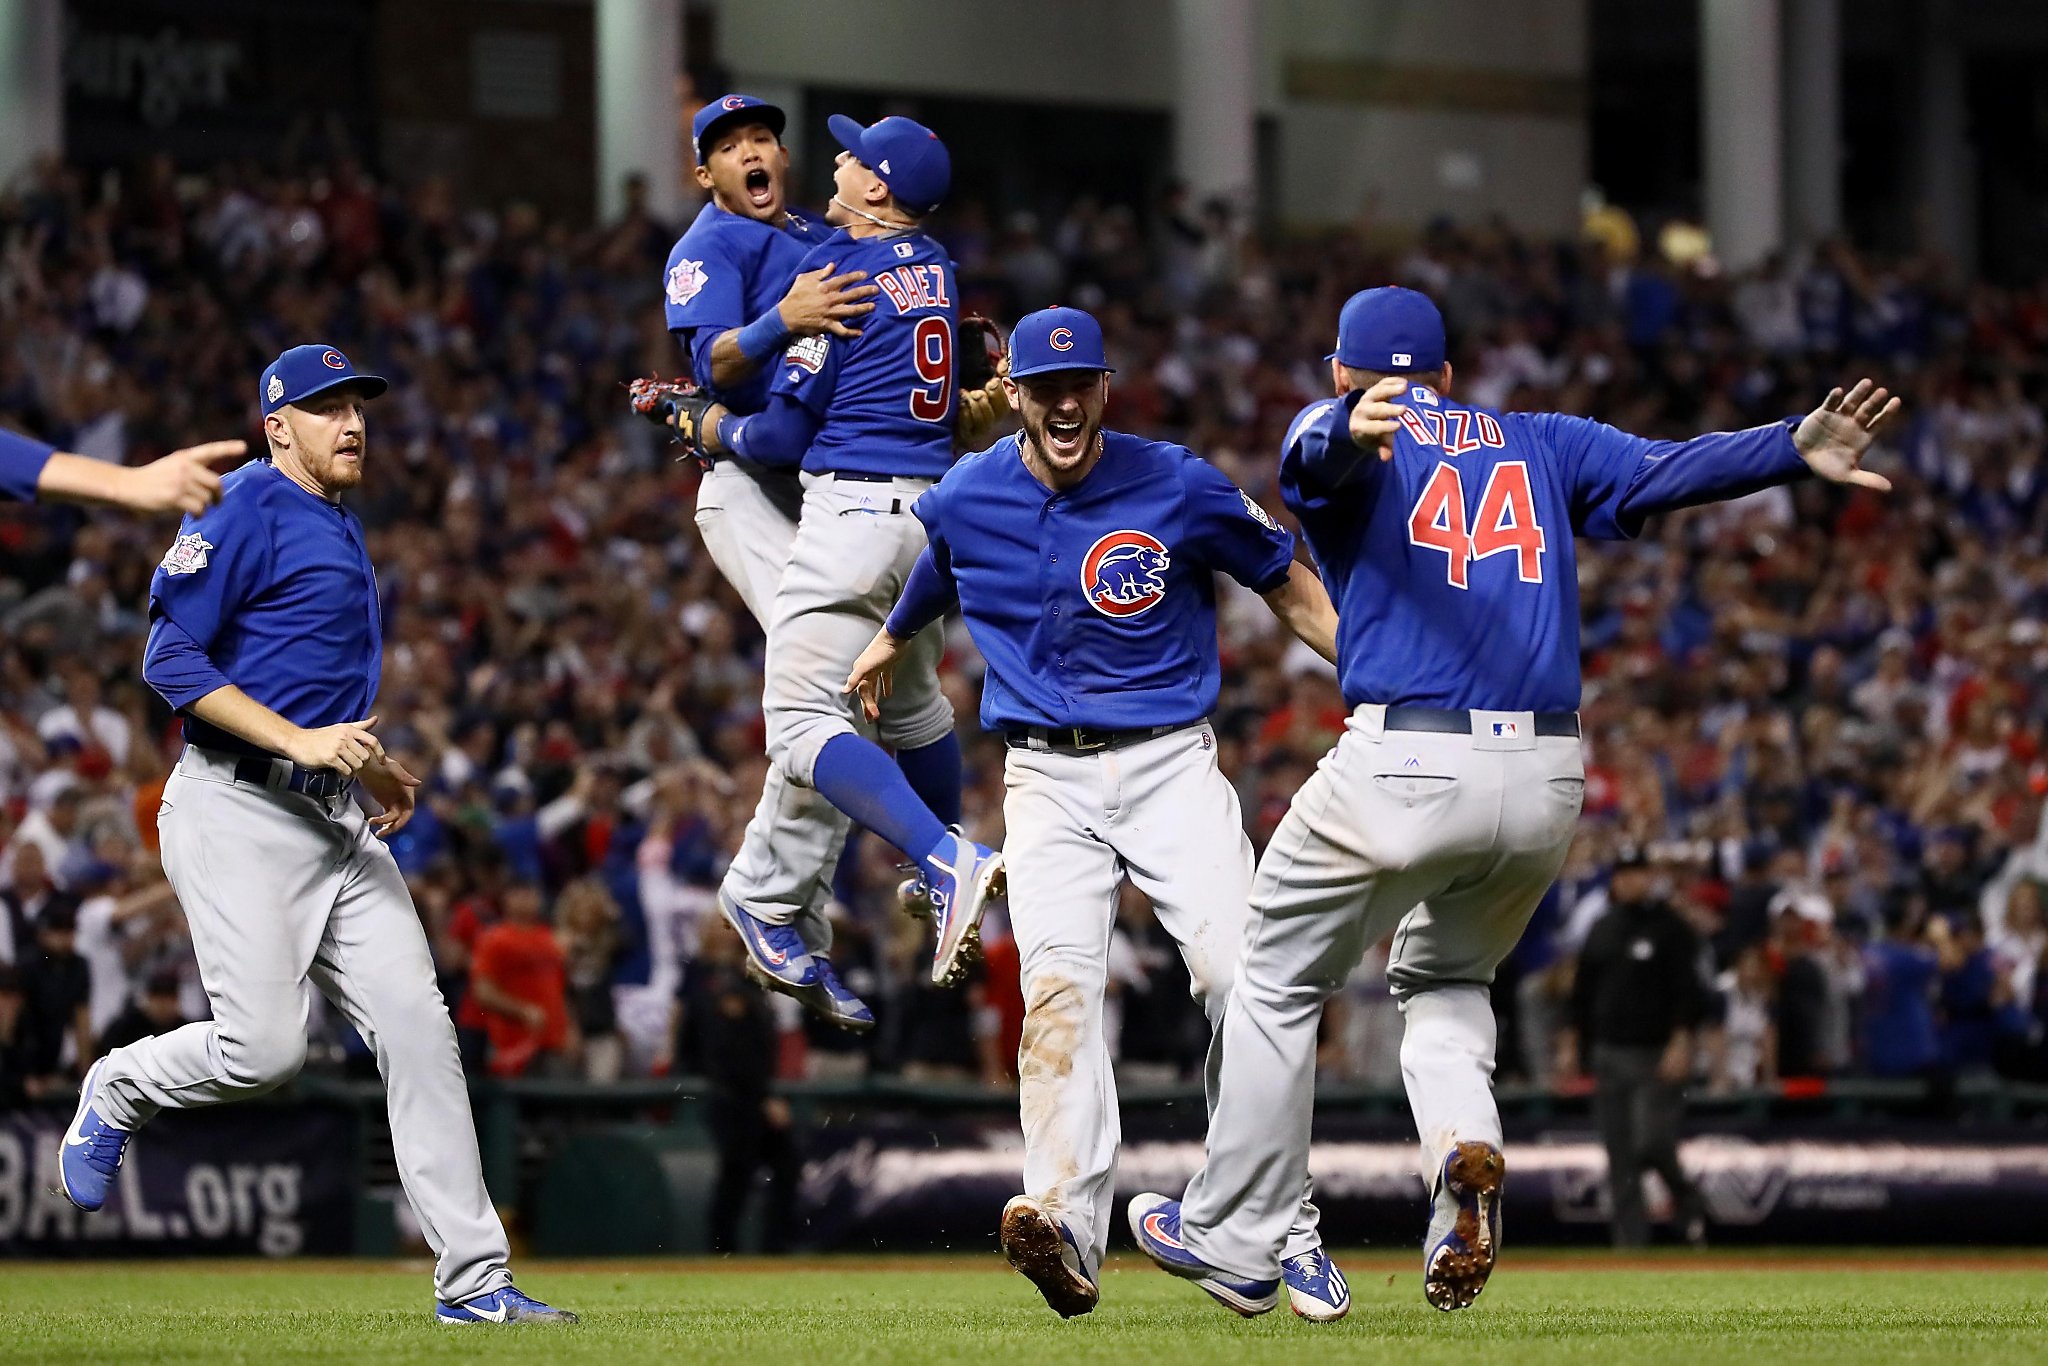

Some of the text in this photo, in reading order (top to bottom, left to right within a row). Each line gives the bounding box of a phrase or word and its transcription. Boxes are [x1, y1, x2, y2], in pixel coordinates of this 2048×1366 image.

[66, 28, 241, 128] urger
[722, 97, 745, 111] C
[875, 265, 950, 315] BAEZ
[796, 336, 827, 353] ORLD
[1050, 327, 1074, 352] C
[322, 350, 346, 370] C
[909, 315, 952, 422] 9
[1408, 460, 1546, 590] 44
